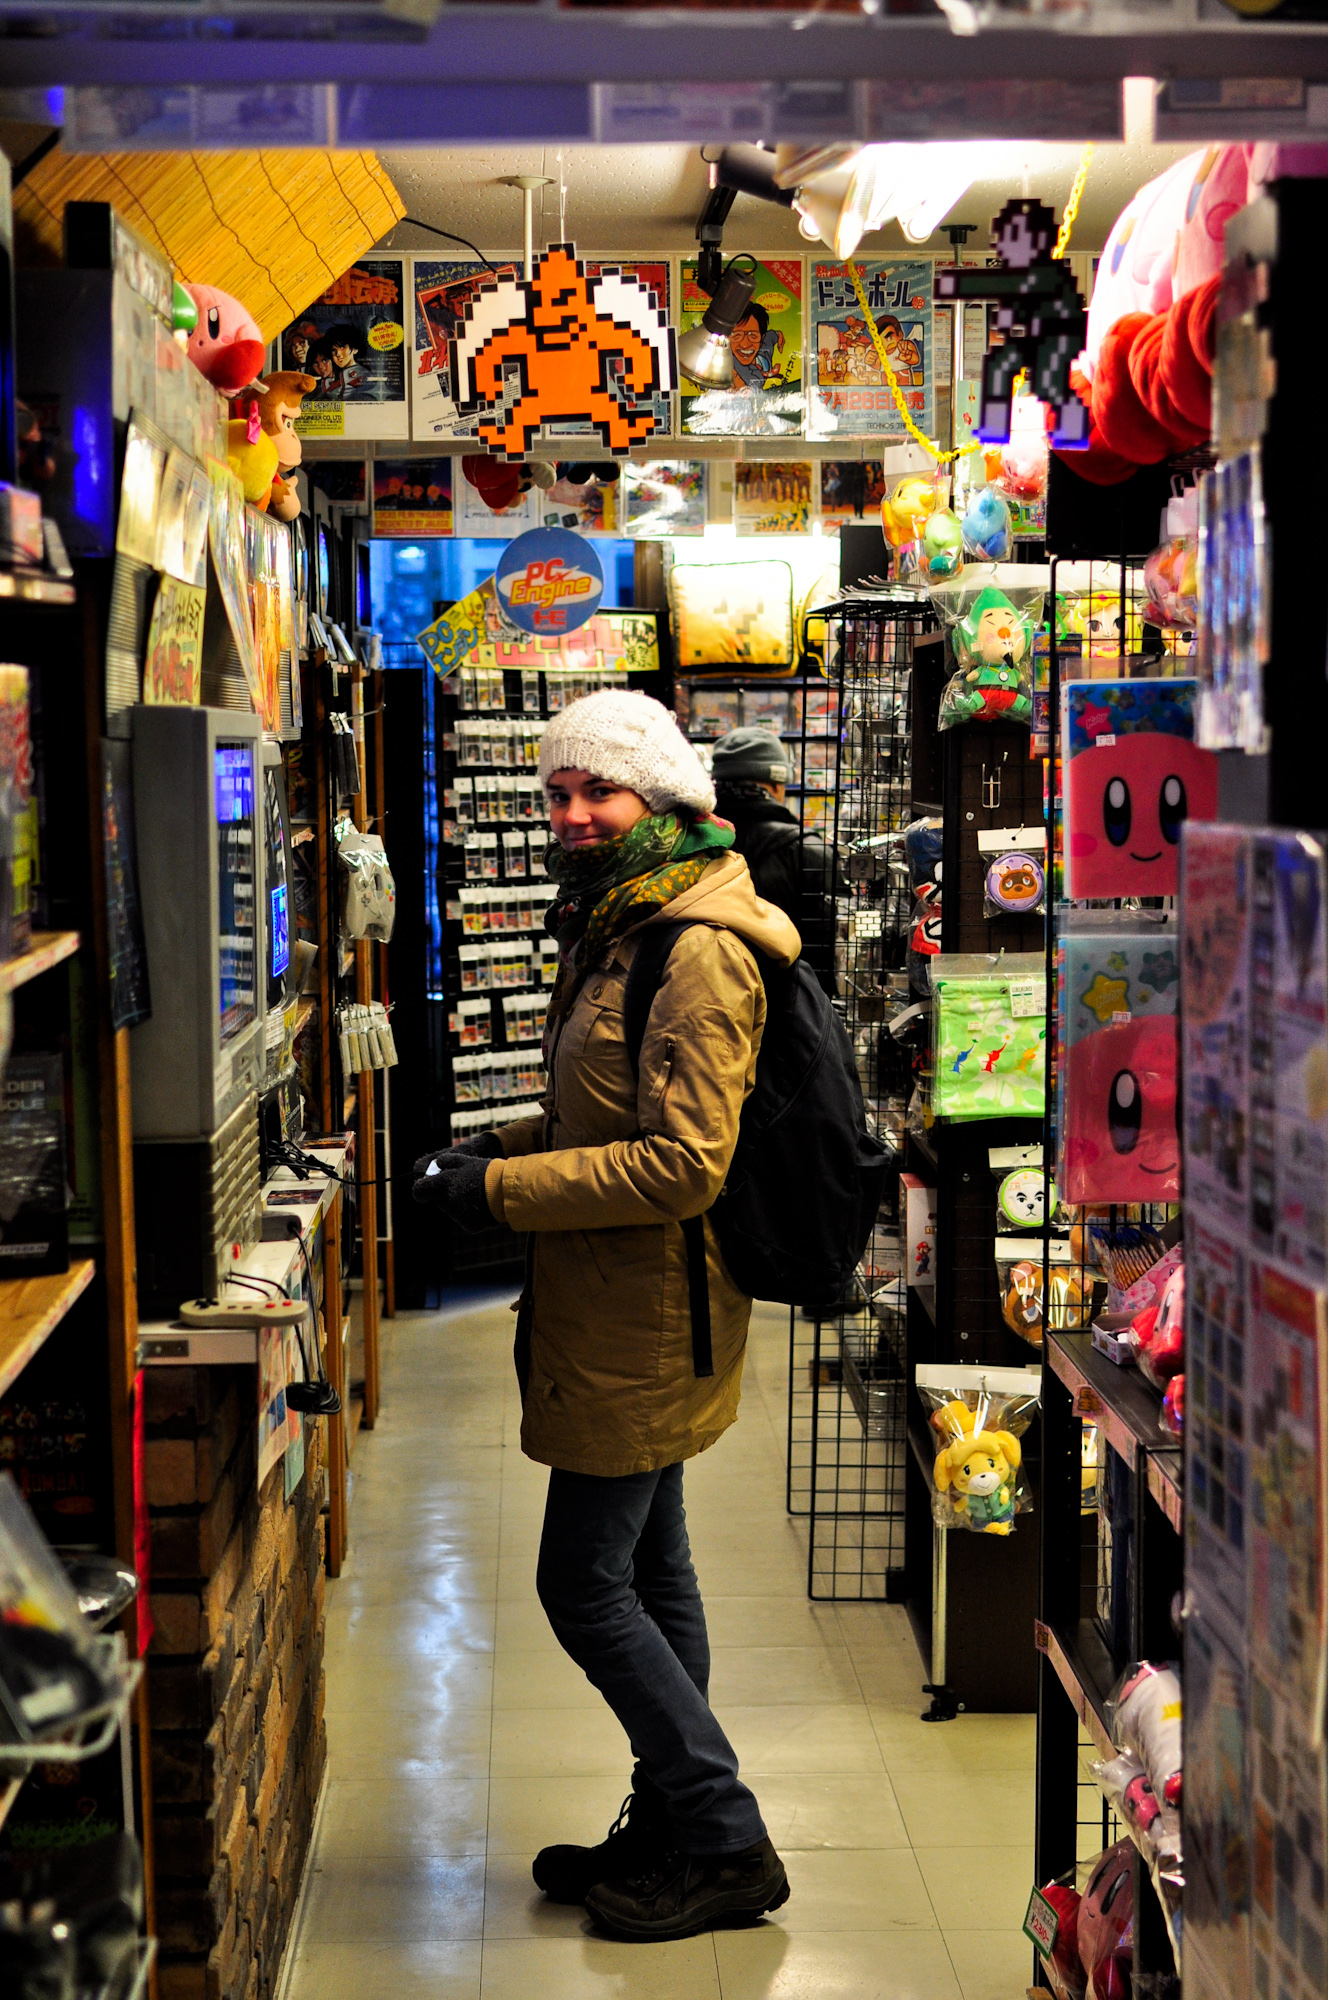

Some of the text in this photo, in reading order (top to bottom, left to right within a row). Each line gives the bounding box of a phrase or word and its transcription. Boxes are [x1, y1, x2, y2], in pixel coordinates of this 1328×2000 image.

[771, 262, 800, 291] 発売予定
[866, 422, 894, 430] TECHNOS
[525, 558, 564, 588] PC
[509, 576, 592, 610] Engine
